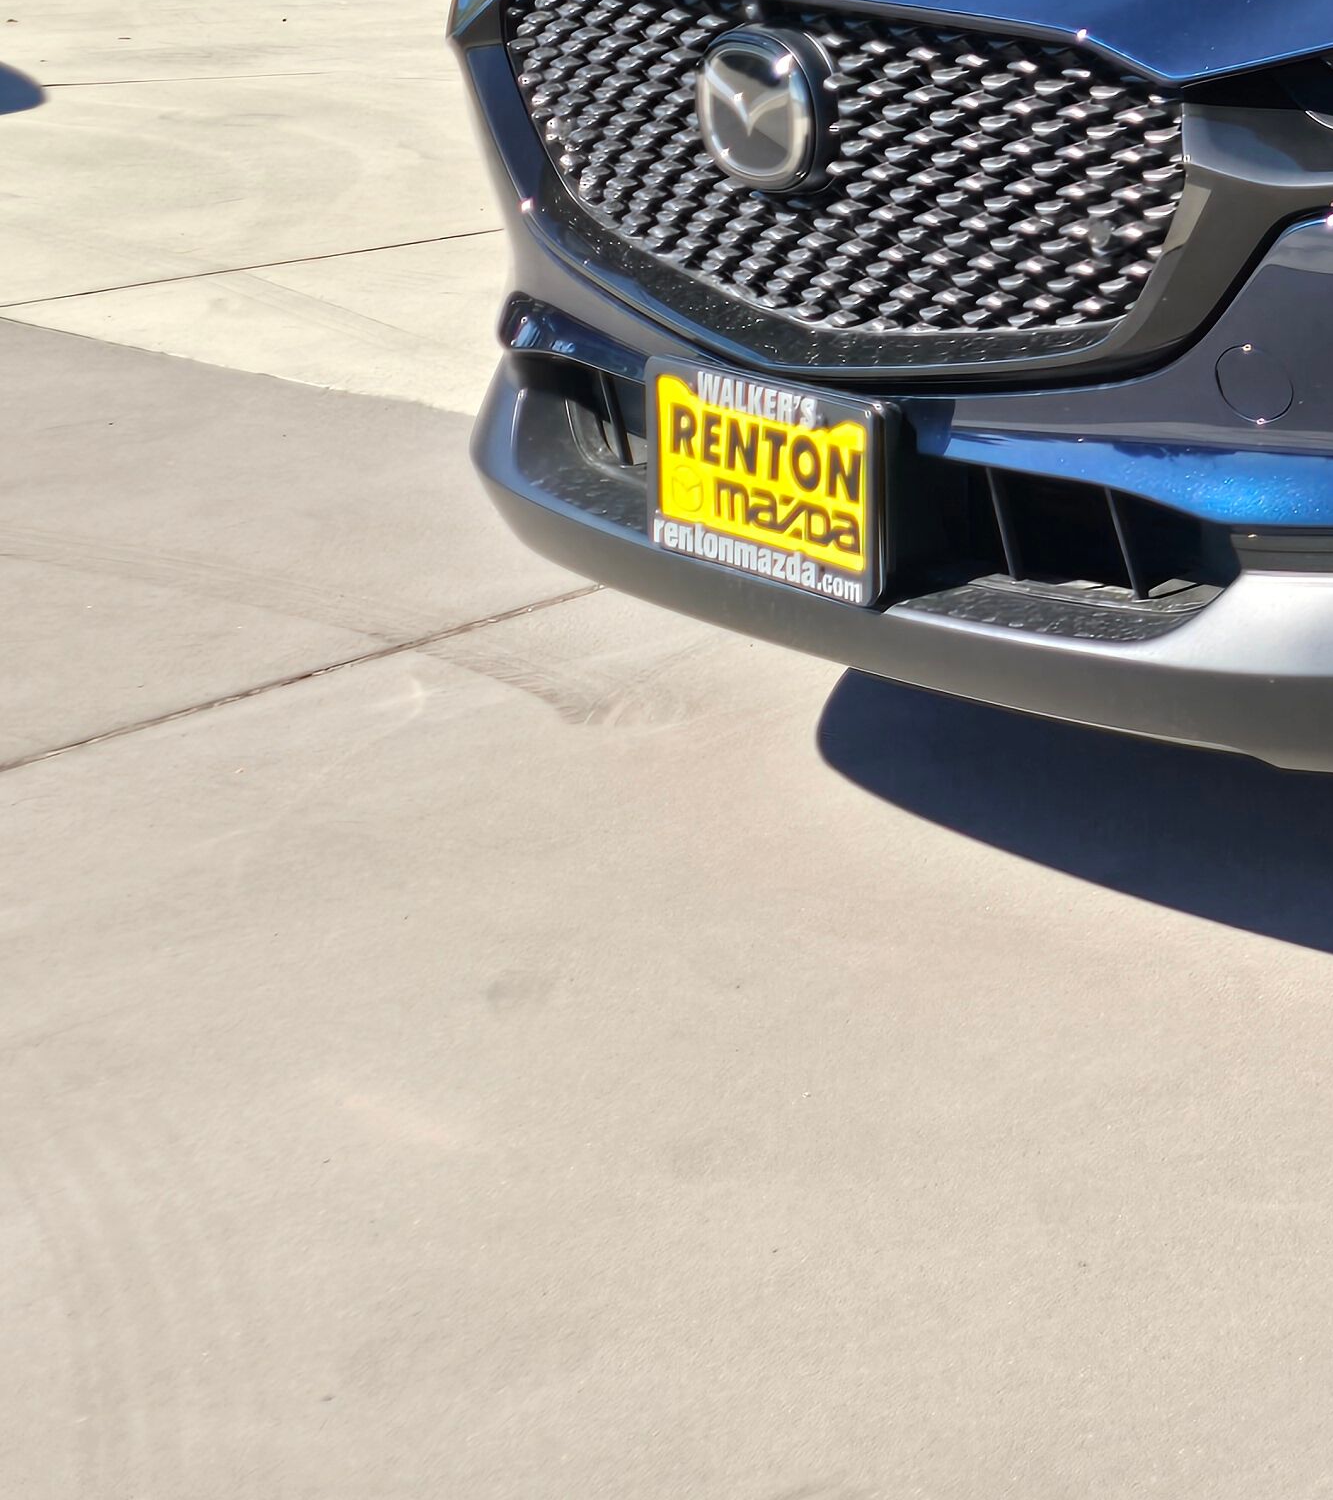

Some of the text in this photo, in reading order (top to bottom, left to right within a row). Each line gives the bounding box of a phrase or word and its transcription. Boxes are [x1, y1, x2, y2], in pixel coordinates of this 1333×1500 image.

[697, 371, 817, 429] WALKER'S
[670, 402, 862, 503] RENTON
[714, 477, 860, 555] mazda
[653, 517, 862, 603] rentonmazda.com
